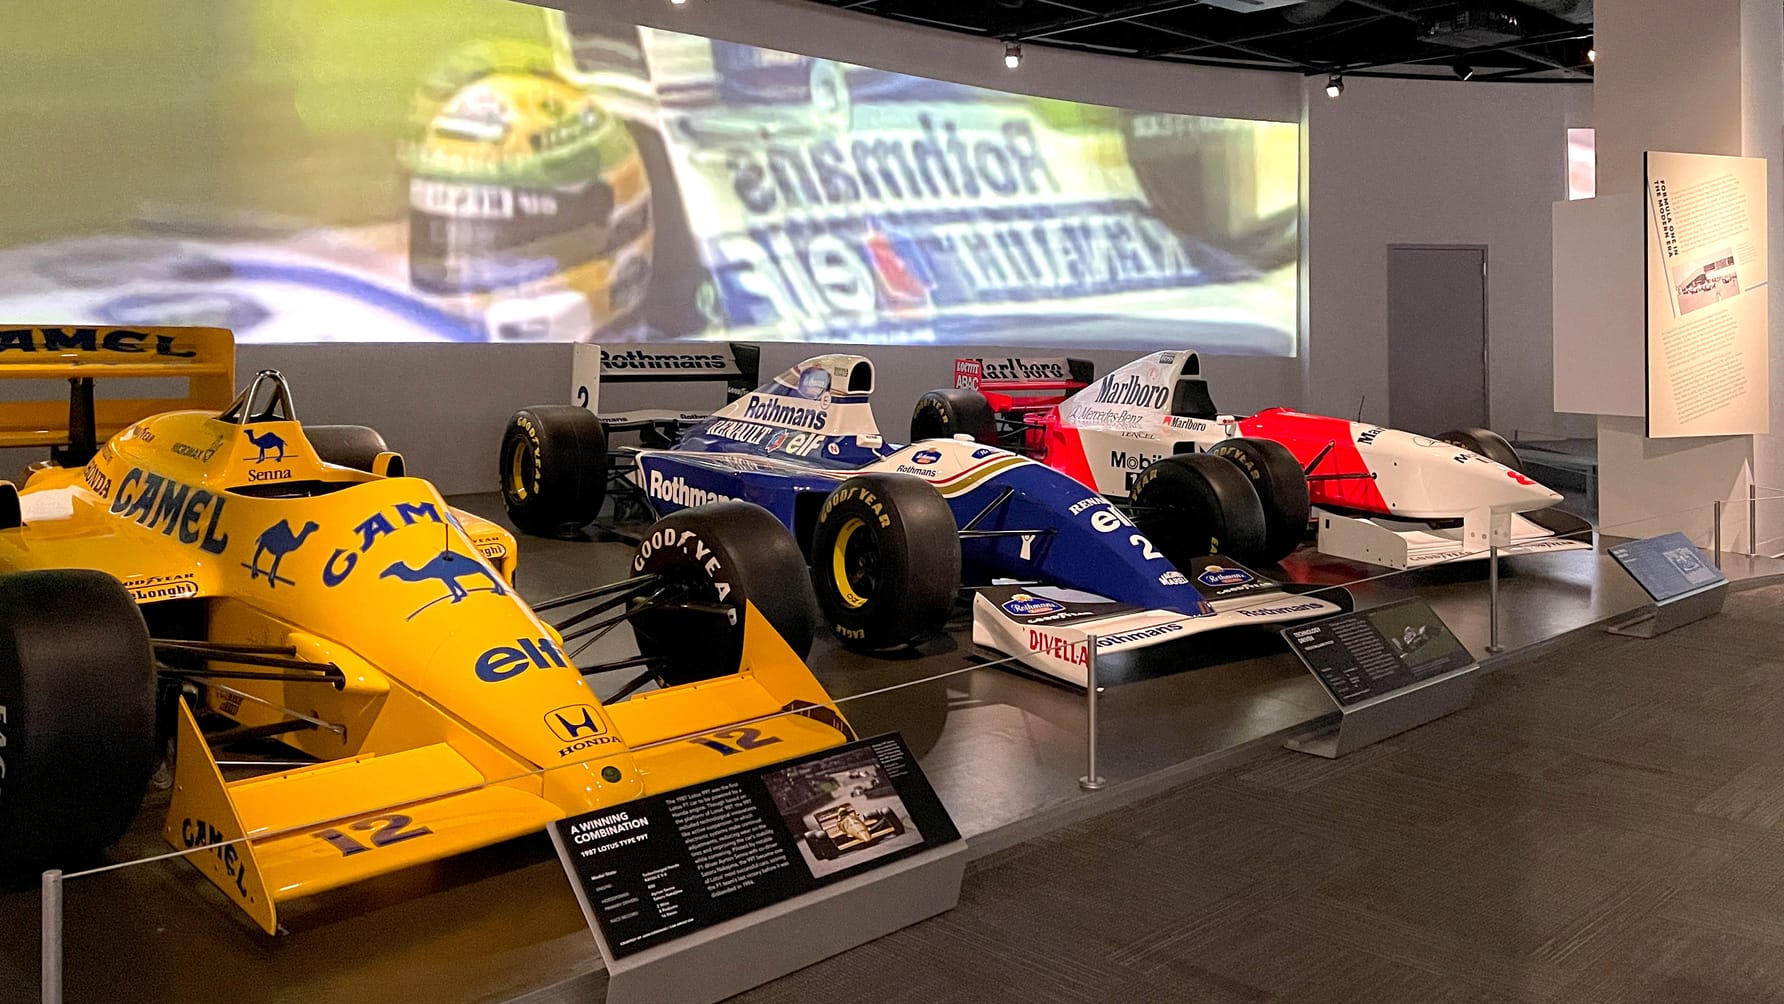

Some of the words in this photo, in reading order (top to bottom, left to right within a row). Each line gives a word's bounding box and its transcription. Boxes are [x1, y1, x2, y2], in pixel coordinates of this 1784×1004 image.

[1658, 199, 1669, 238] MODERN
[1660, 180, 1672, 223] FORMULA
[1669, 225, 1677, 243] ONE
[0, 328, 197, 358] AMEL
[599, 350, 727, 370] Rothmans
[956, 361, 979, 374] LOCTITE
[955, 374, 979, 391] ABAC
[1094, 373, 1170, 409] Marlboro
[744, 395, 828, 431] Rothmans
[1080, 406, 1144, 425] Mercedes-Benz
[1171, 416, 1207, 432] Marlboro
[705, 420, 774, 446] RENAULT
[785, 432, 827, 457] elf
[1121, 430, 1156, 440] TENCEL
[516, 416, 542, 495] GOODYEAR
[1111, 450, 1163, 470] Mob
[248, 468, 293, 482] Senna
[896, 464, 937, 477] Rothmans
[650, 469, 745, 507] Rothman
[111, 467, 228, 555] CAMEL
[819, 487, 891, 529] GOODYEAR
[323, 502, 445, 588] CAM
[1128, 533, 1167, 561] 2
[122, 573, 195, 586] ODYEAR
[131, 583, 193, 599] eLonghi
[1012, 602, 1058, 613] Rothmans
[1096, 621, 1184, 648] othmans
[475, 637, 568, 683] elf
[1029, 628, 1089, 669] DIVELLA
[558, 735, 623, 758] HONDA
[686, 727, 784, 757] 12
[312, 814, 434, 857] 12
[571, 825, 579, 834] A
[578, 811, 628, 831] WINNING
[574, 816, 648, 843] COMBINATION
[181, 818, 248, 898] CAMEL
[580, 848, 596, 856] 1987
[597, 841, 619, 852] LOTUS
[618, 837, 636, 846] TYPE
[635, 833, 648, 841] 99T
